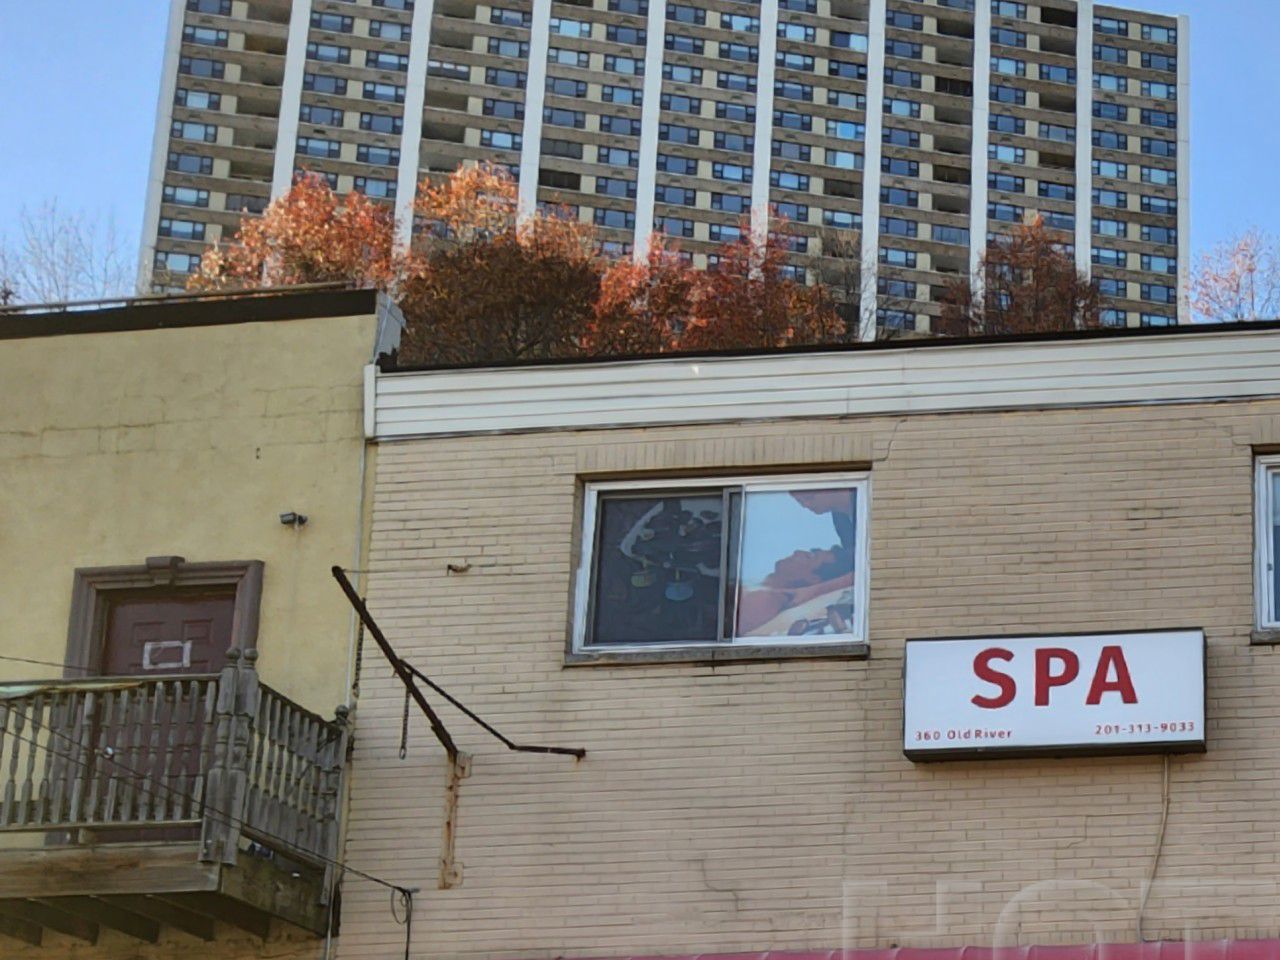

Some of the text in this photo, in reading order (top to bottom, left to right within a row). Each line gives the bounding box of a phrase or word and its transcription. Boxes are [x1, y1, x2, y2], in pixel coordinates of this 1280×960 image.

[971, 645, 1138, 709] SPA
[915, 728, 1013, 741] 360 Old River
[1095, 721, 1196, 735] 201-313-9033
